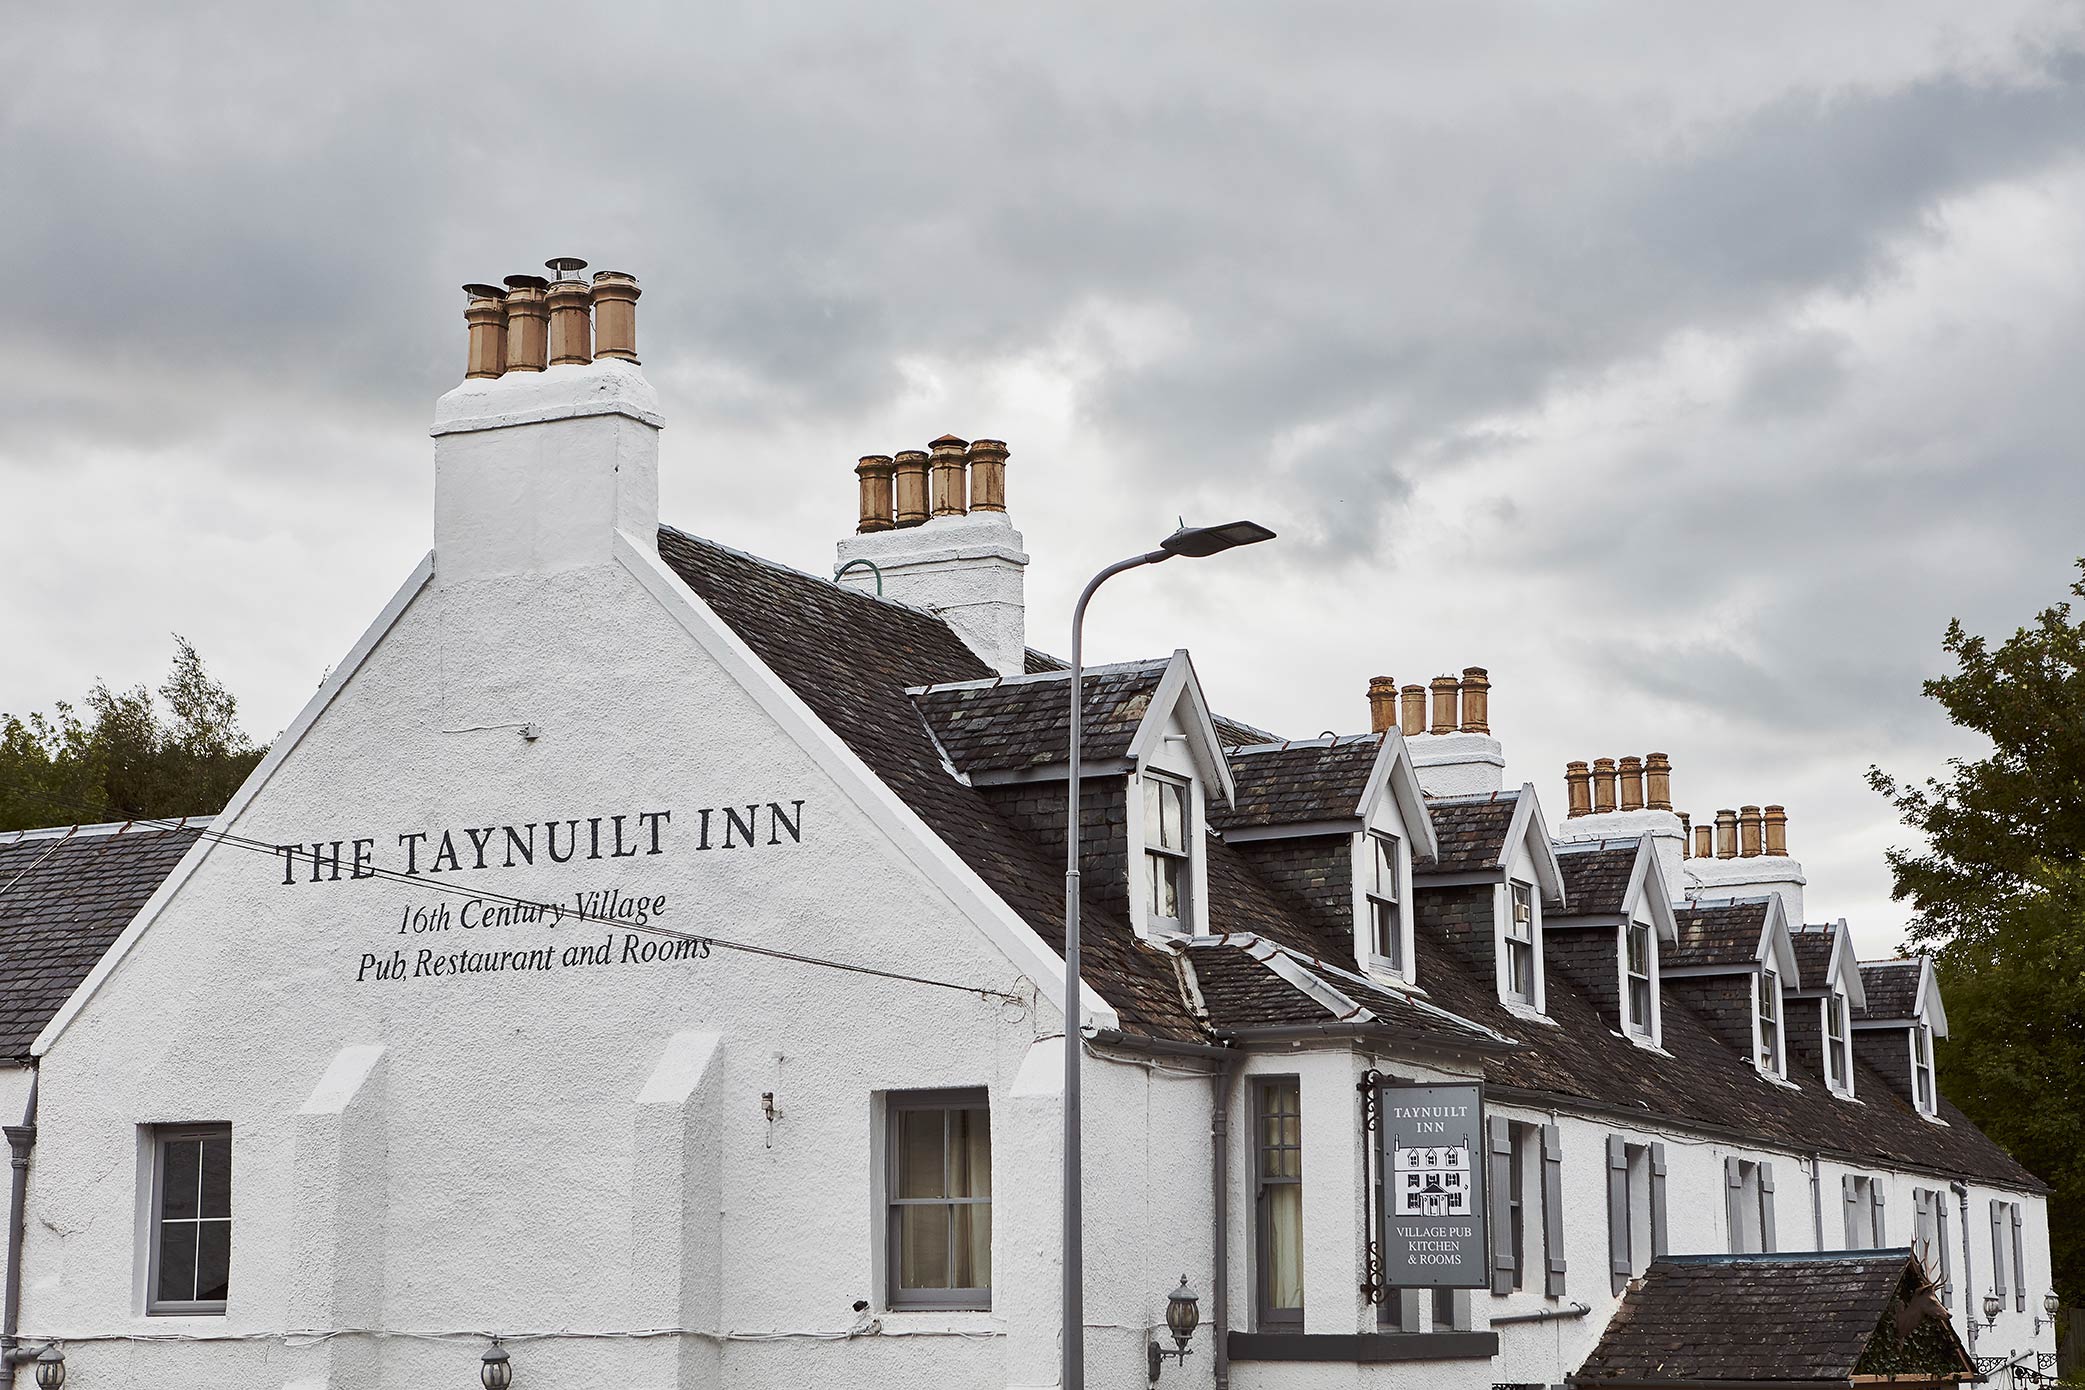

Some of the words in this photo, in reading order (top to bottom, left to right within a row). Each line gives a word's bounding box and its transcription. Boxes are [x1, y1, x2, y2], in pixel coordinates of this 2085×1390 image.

[276, 838, 375, 885] THE
[399, 810, 671, 875] TAYNUILT
[695, 800, 806, 850] INN
[398, 903, 451, 934] 16th
[460, 900, 566, 928] Century
[575, 889, 666, 924] Village
[356, 951, 406, 982] Pub,
[413, 946, 556, 977] Restaurant
[562, 935, 612, 967] and
[620, 934, 713, 964] Rooms
[1393, 1106, 1468, 1118] TAYNUILT
[1416, 1122, 1445, 1133] INN
[1396, 1228, 1447, 1238] VILLAGE
[1449, 1227, 1472, 1237] PUB
[1408, 1241, 1460, 1251] KITCHEN
[1407, 1255, 1417, 1265] &
[1419, 1255, 1462, 1265] ROOMS
